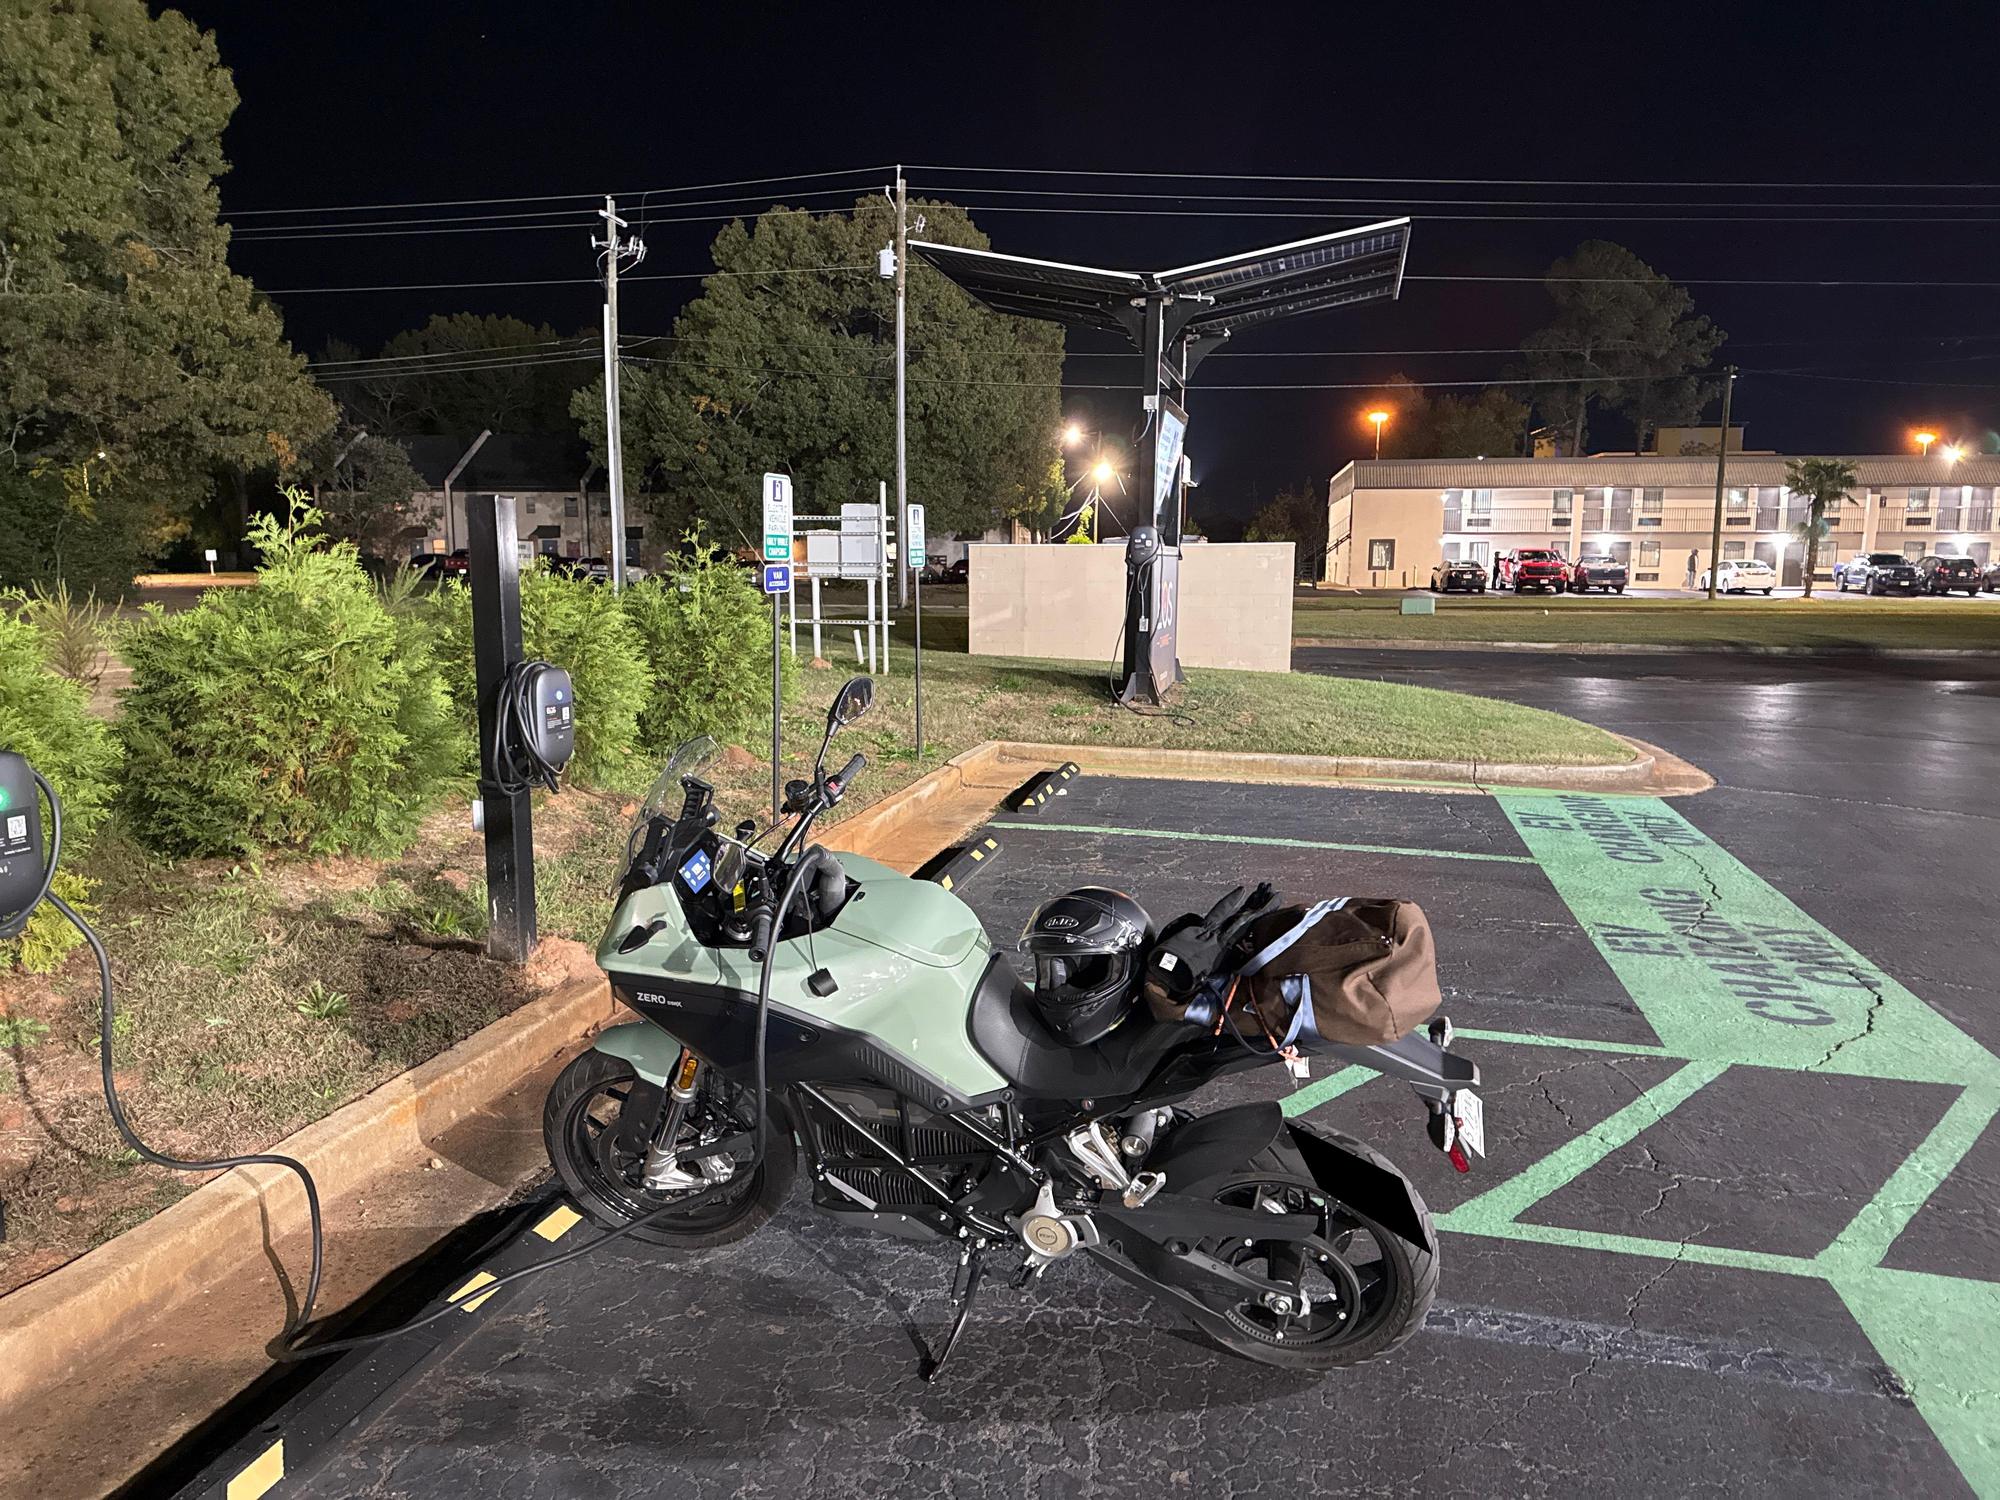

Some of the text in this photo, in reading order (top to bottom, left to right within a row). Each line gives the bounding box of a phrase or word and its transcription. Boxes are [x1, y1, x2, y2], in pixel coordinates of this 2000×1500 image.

[1515, 811, 1575, 831] EV
[1554, 794, 1664, 864] CHARGING
[1622, 810, 1706, 846] ONLY
[1594, 922, 1685, 958] EV
[1639, 888, 1836, 1026] CHARGING
[1743, 921, 1882, 988] ONLY
[636, 992, 666, 1005] ZERO
